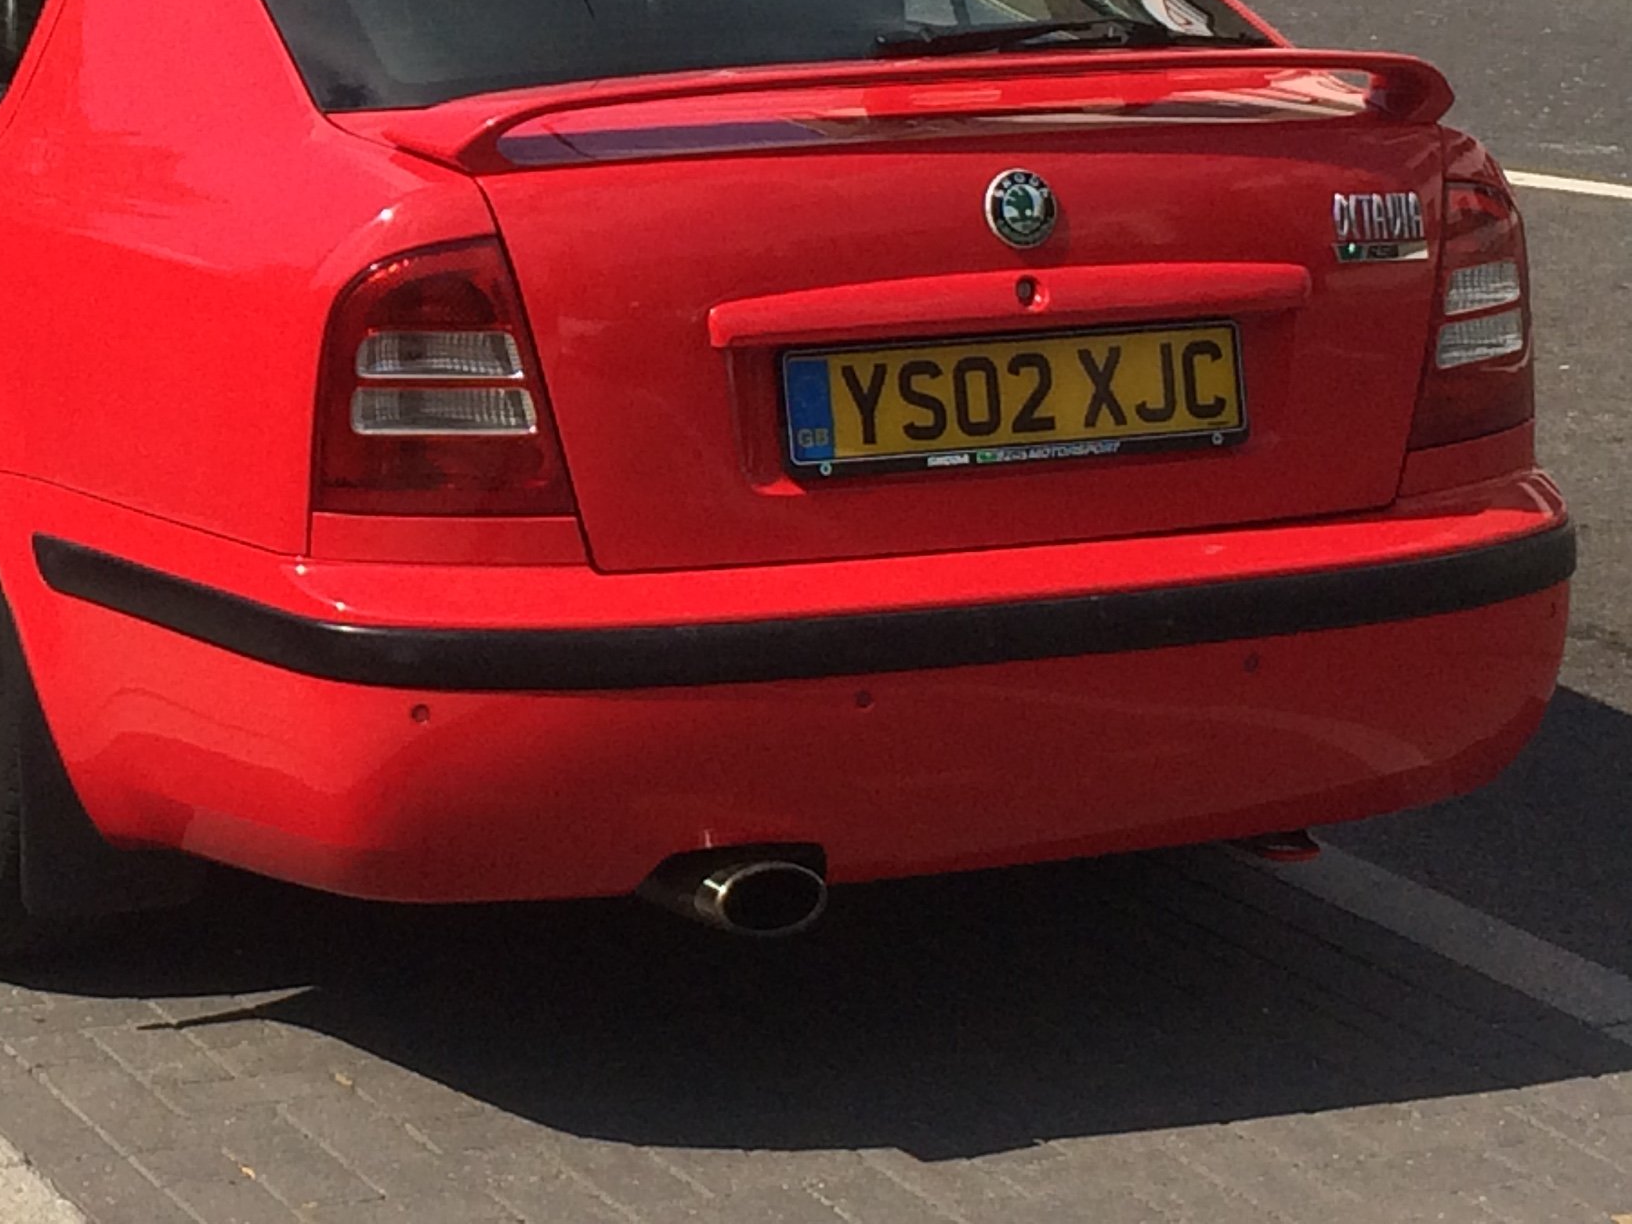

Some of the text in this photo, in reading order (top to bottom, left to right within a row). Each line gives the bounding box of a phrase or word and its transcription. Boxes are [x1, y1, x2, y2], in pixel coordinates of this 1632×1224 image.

[1333, 192, 1424, 240] OCTAVIA
[841, 339, 1227, 445] YS02 XJC
[798, 428, 829, 448] GB
